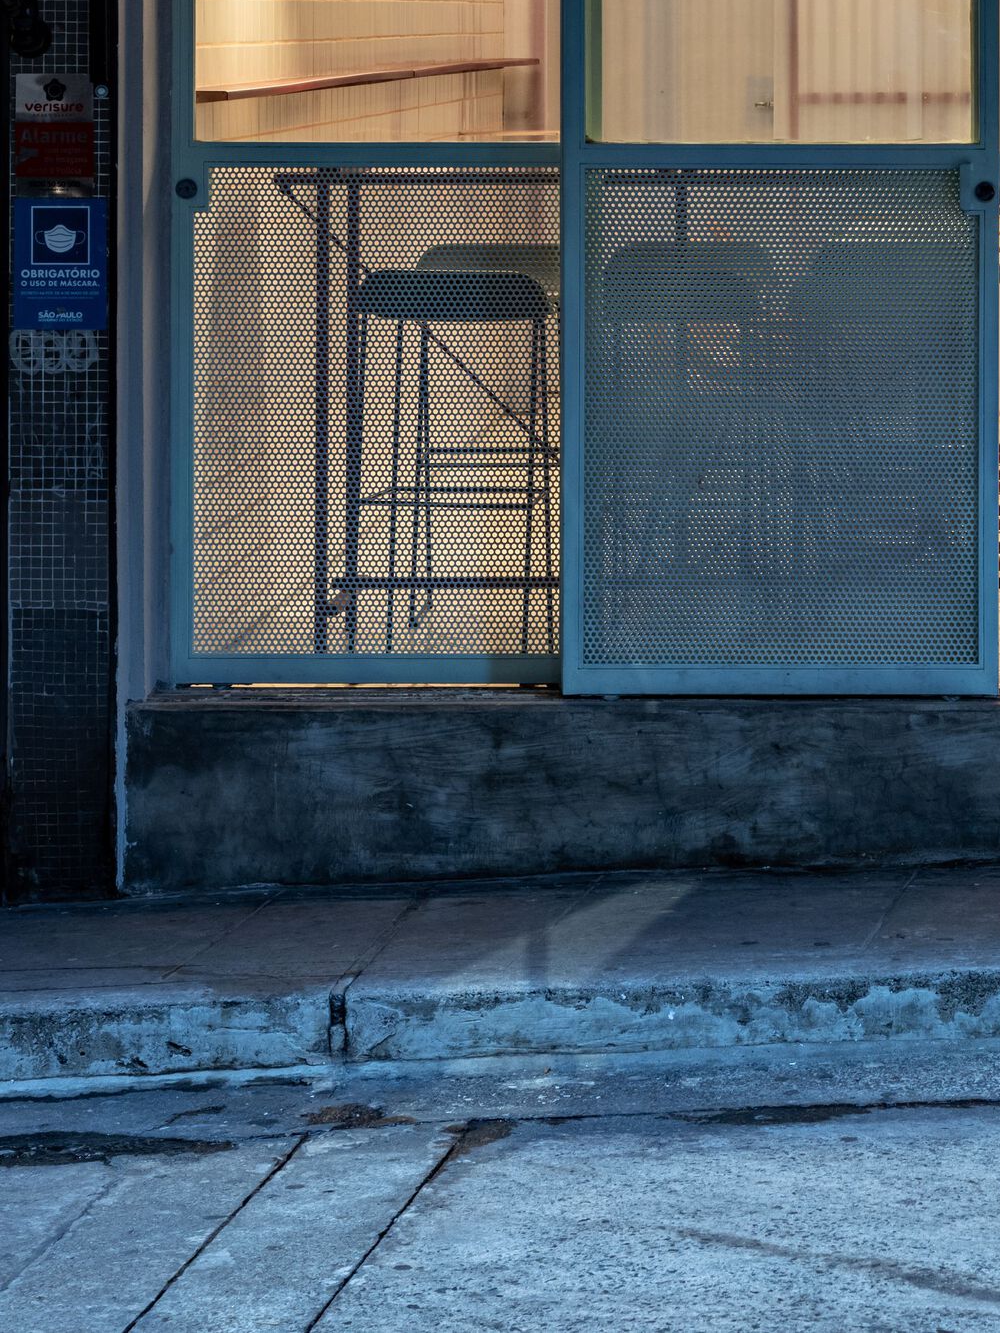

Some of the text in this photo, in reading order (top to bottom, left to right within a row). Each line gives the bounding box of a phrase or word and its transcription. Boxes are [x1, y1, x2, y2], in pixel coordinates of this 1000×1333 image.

[25, 102, 84, 112] verisure
[21, 129, 89, 144] Alarme
[21, 267, 100, 279] OBRIGATÓRIO
[38, 310, 83, 319] SÃO PAULO
